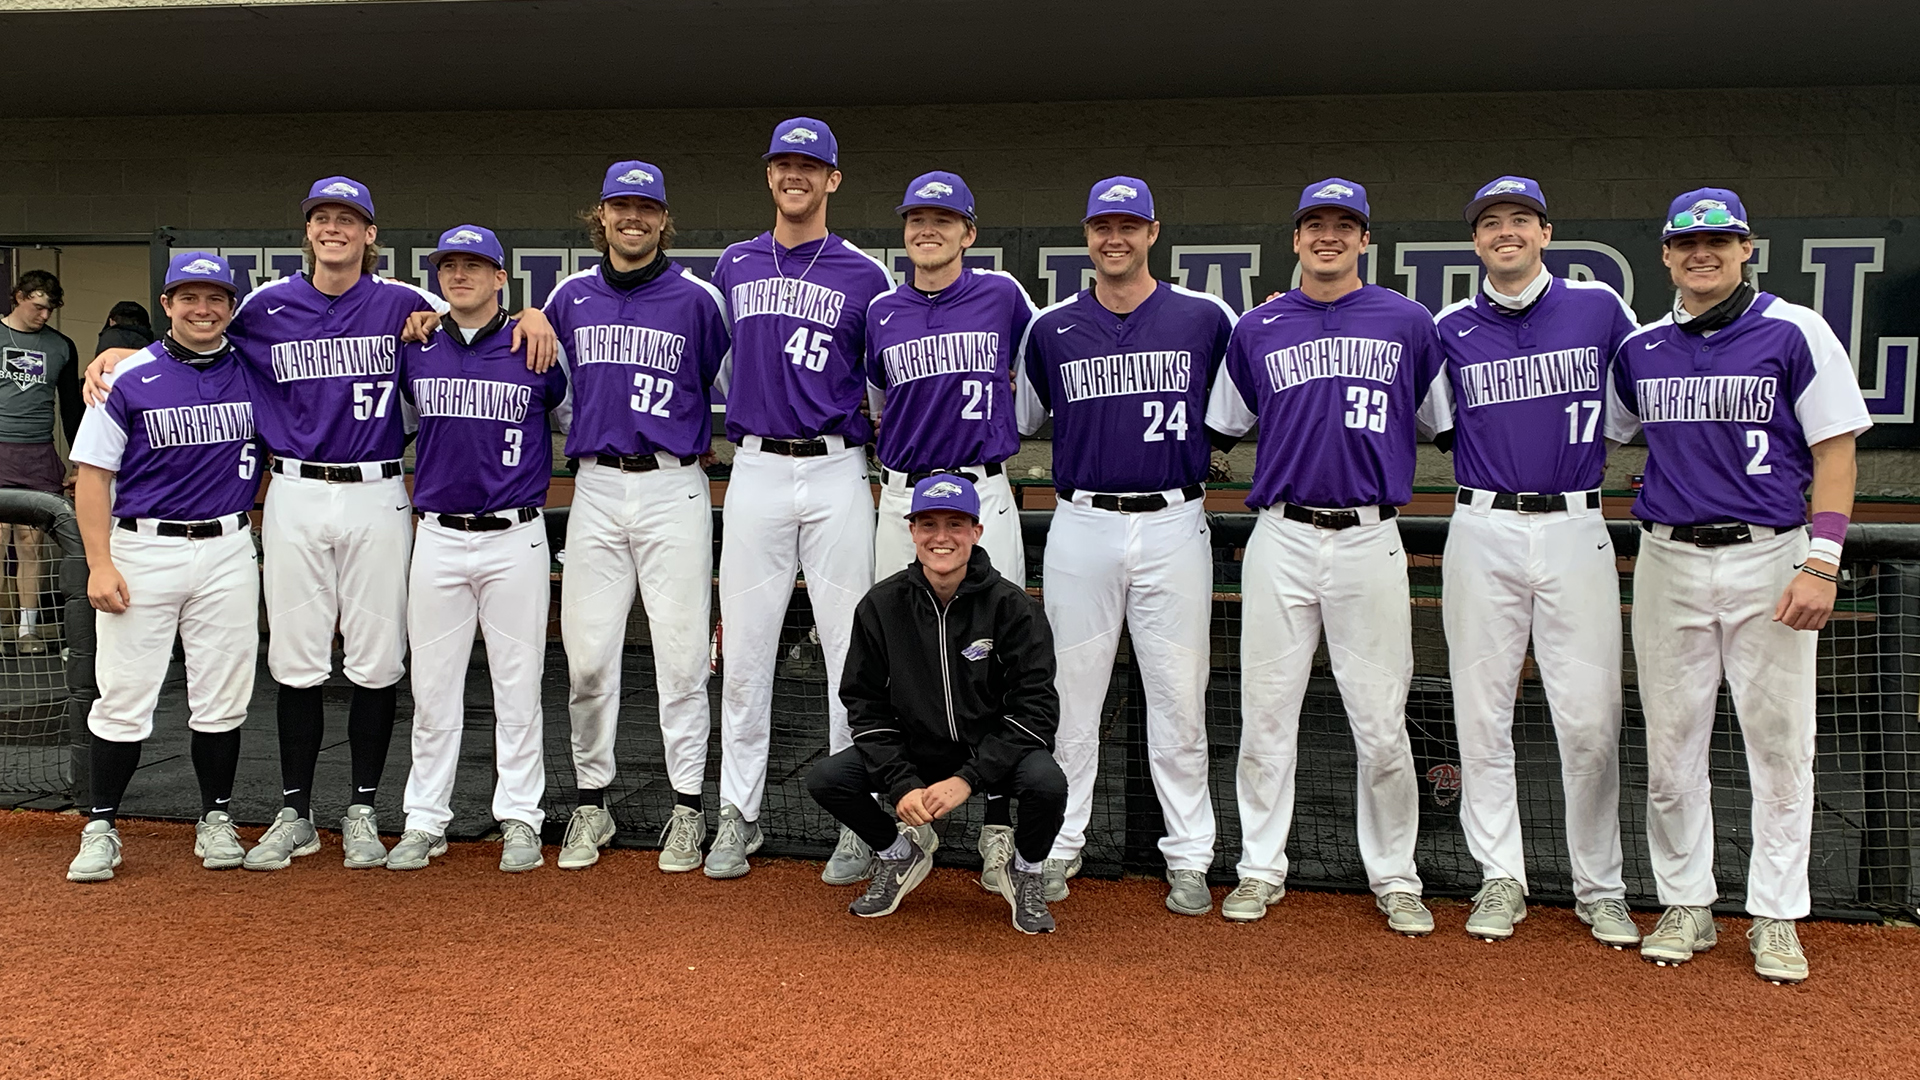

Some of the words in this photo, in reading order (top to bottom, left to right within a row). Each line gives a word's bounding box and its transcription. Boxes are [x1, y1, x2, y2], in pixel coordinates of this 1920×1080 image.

[731, 277, 846, 329] WARHAWKS
[271, 335, 396, 383] WARHAWKS
[574, 324, 686, 374] WARHAWKS
[784, 326, 833, 373] 45
[883, 332, 999, 387] WARHAWKS
[1265, 336, 1403, 393] WARHAWKS
[0, 370, 48, 385] BASEBALL
[353, 380, 394, 420] 57
[413, 377, 532, 424] WARHAWKS
[630, 372, 674, 418] 32
[961, 380, 993, 420] 21
[1059, 351, 1191, 403] WARHAWKS
[1460, 346, 1600, 408] WARHAWKS
[1636, 373, 1777, 423] WARHAWKS
[143, 401, 255, 449] WARHAWK
[1143, 400, 1189, 442] 24
[1345, 386, 1388, 434] 33
[1565, 400, 1602, 444] 17
[238, 442, 256, 480] 5
[502, 428, 523, 467] 3
[1746, 429, 1772, 475] 2
